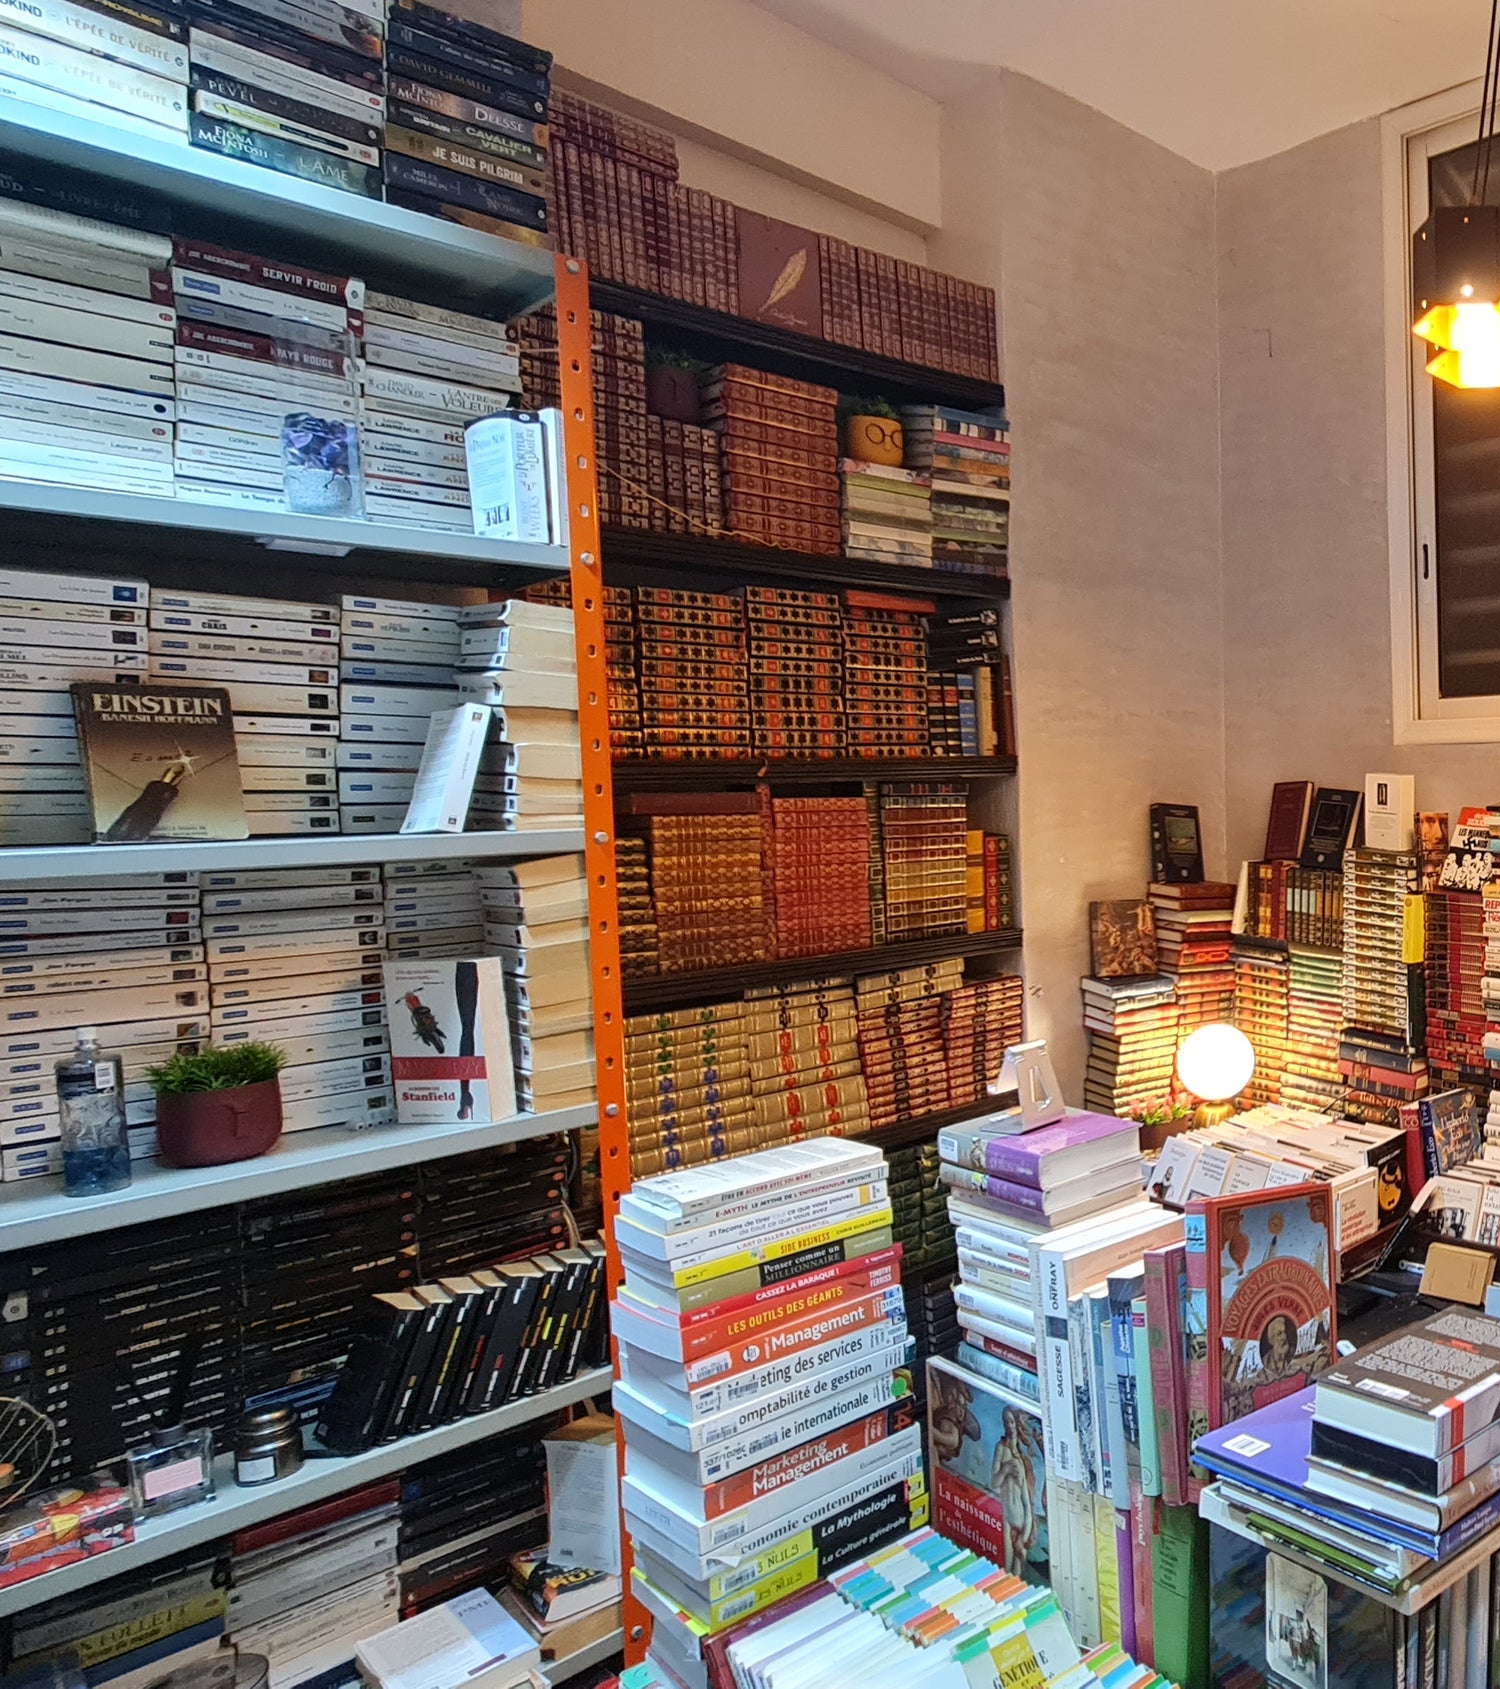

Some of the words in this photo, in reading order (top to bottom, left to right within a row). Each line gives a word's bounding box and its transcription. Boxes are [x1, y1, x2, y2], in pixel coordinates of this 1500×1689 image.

[110, 33, 124, 46] DE
[208, 79, 256, 104] PEVEL
[214, 125, 253, 146] FIONA
[466, 127, 532, 154] CAVALIER
[481, 140, 516, 157] VERT
[432, 147, 447, 160] JE
[451, 152, 476, 169] SUIS
[480, 161, 523, 184] PILGRIM
[262, 267, 302, 285] SERVIR
[306, 279, 337, 294] FROID
[91, 693, 224, 716] EINSTEIN
[101, 713, 151, 723] BANESH
[154, 715, 218, 725] HOFFMANN
[402, 1092, 455, 1101] Stanfield
[715, 1204, 748, 1218] E-MYTH
[760, 1196, 782, 1207] MYTHE
[718, 1223, 743, 1235] façons
[756, 1215, 771, 1225] tirer
[797, 1205, 810, 1215] que
[812, 1200, 828, 1209] vous
[829, 1193, 854, 1205] pouvez
[750, 1223, 766, 1233] tout
[778, 1215, 792, 1225] que
[793, 1211, 810, 1220] vous
[763, 1259, 793, 1274] Penser
[795, 1250, 826, 1265] comme
[828, 1245, 840, 1254] un
[780, 1242, 796, 1254] SIDE
[798, 1232, 831, 1249] BUSINESS
[765, 1253, 841, 1283] MILLIONNAIRE
[755, 1285, 785, 1301] CASSEZ
[787, 1282, 798, 1292] LA
[798, 1272, 836, 1288] BARAQUE
[1049, 1261, 1060, 1310] ONFRAY
[727, 1319, 746, 1336] LES
[749, 1306, 784, 1328] OUTILS
[786, 1299, 805, 1317] DES
[807, 1286, 844, 1308] GÉANTS
[1225, 1276, 1258, 1332] VOYAGES
[772, 1307, 865, 1350] Management
[794, 1355, 814, 1373] des
[817, 1337, 863, 1362] services
[1057, 1345, 1066, 1398] SAGESSE
[814, 1380, 828, 1393] de
[831, 1365, 872, 1391] gestion
[794, 1391, 869, 1434] internationale
[752, 1439, 827, 1481] Marketing
[752, 1442, 848, 1496] Management
[803, 1469, 898, 1525] contemporaine
[938, 1483, 953, 1501] La
[954, 1494, 1002, 1532] naissance
[821, 1526, 835, 1538] La
[837, 1492, 897, 1530] Mythologie
[822, 1552, 834, 1565] La
[836, 1535, 868, 1560] Culture
[869, 1516, 906, 1542] générale
[938, 1509, 999, 1556] l'esthétique
